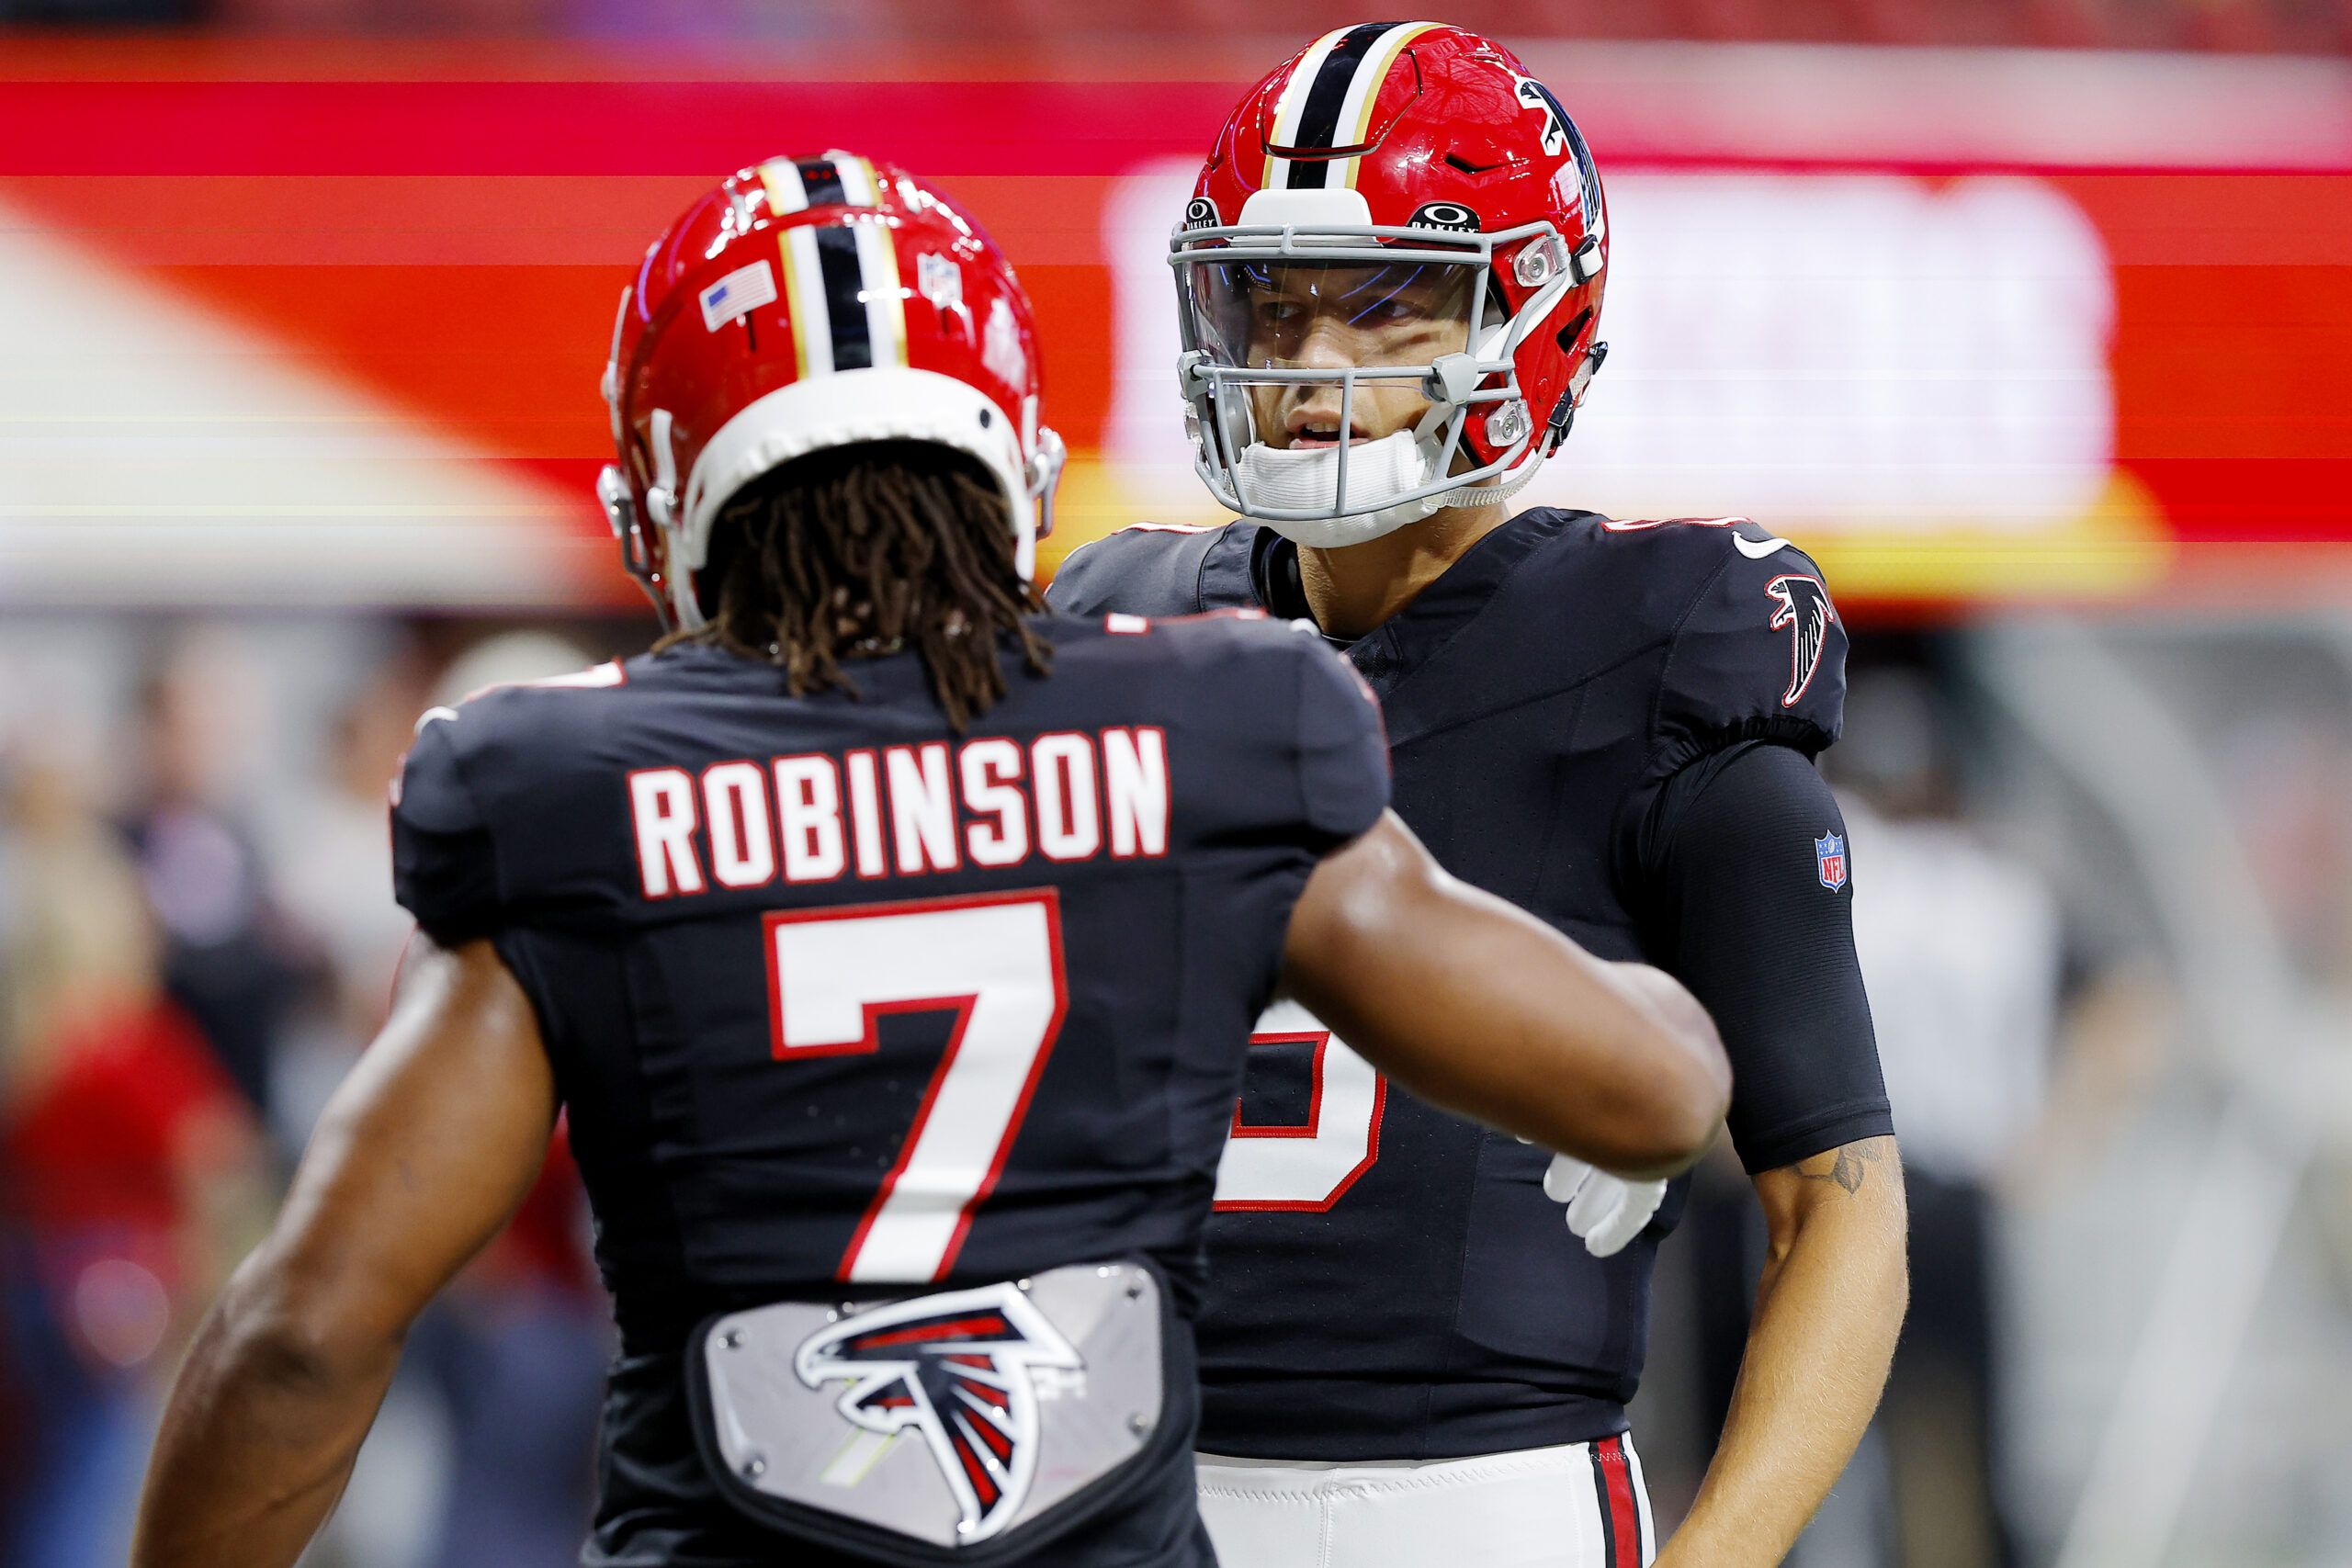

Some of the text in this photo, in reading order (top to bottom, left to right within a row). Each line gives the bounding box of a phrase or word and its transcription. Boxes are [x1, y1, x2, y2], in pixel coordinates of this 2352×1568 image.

[1411, 221, 1478, 233] OAKLEY
[627, 725, 1172, 900] ROBINSON
[1822, 856, 1845, 884] NFL
[762, 886, 1069, 1284] 7
